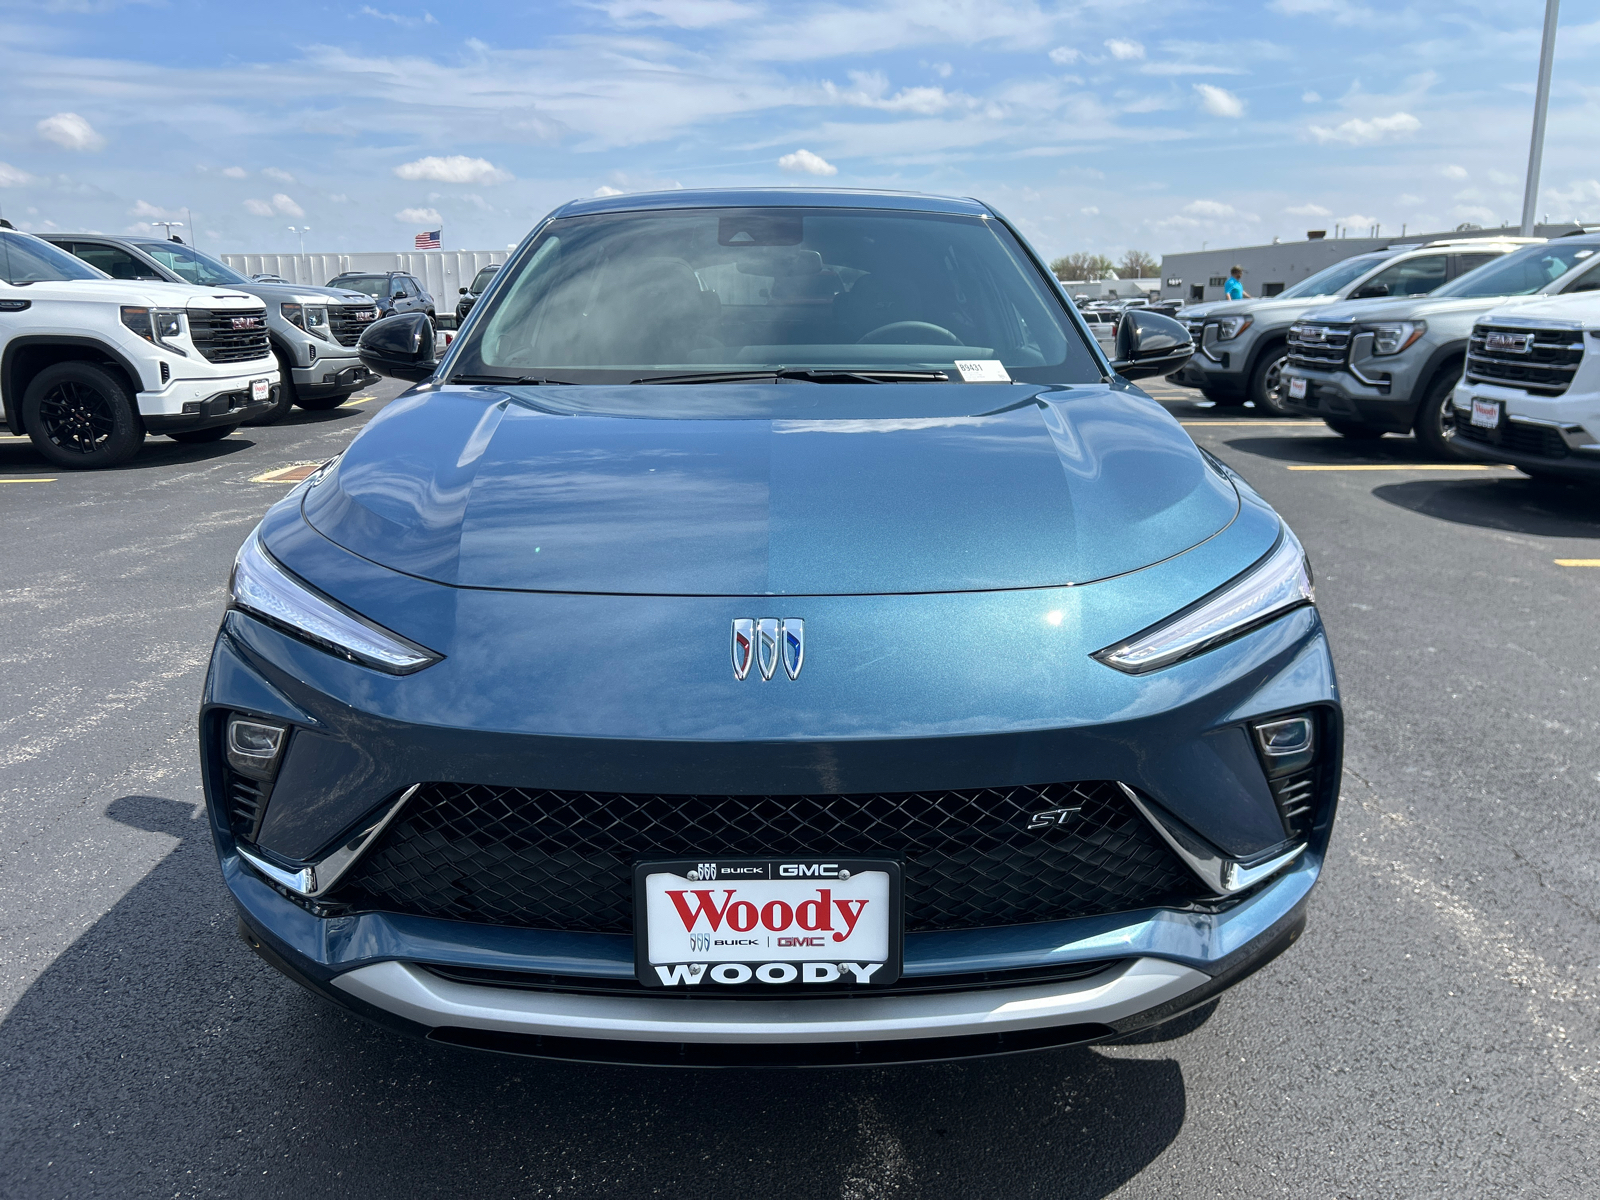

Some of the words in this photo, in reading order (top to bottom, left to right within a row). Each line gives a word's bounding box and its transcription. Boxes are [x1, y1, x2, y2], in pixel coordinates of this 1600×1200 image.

[1487, 335, 1527, 351] GMC
[1475, 402, 1497, 416] Woody
[1027, 807, 1082, 829] ST
[779, 863, 839, 876] GMC
[665, 889, 869, 942] Woody
[777, 936, 825, 947] GMC
[655, 963, 883, 986] WOODY
